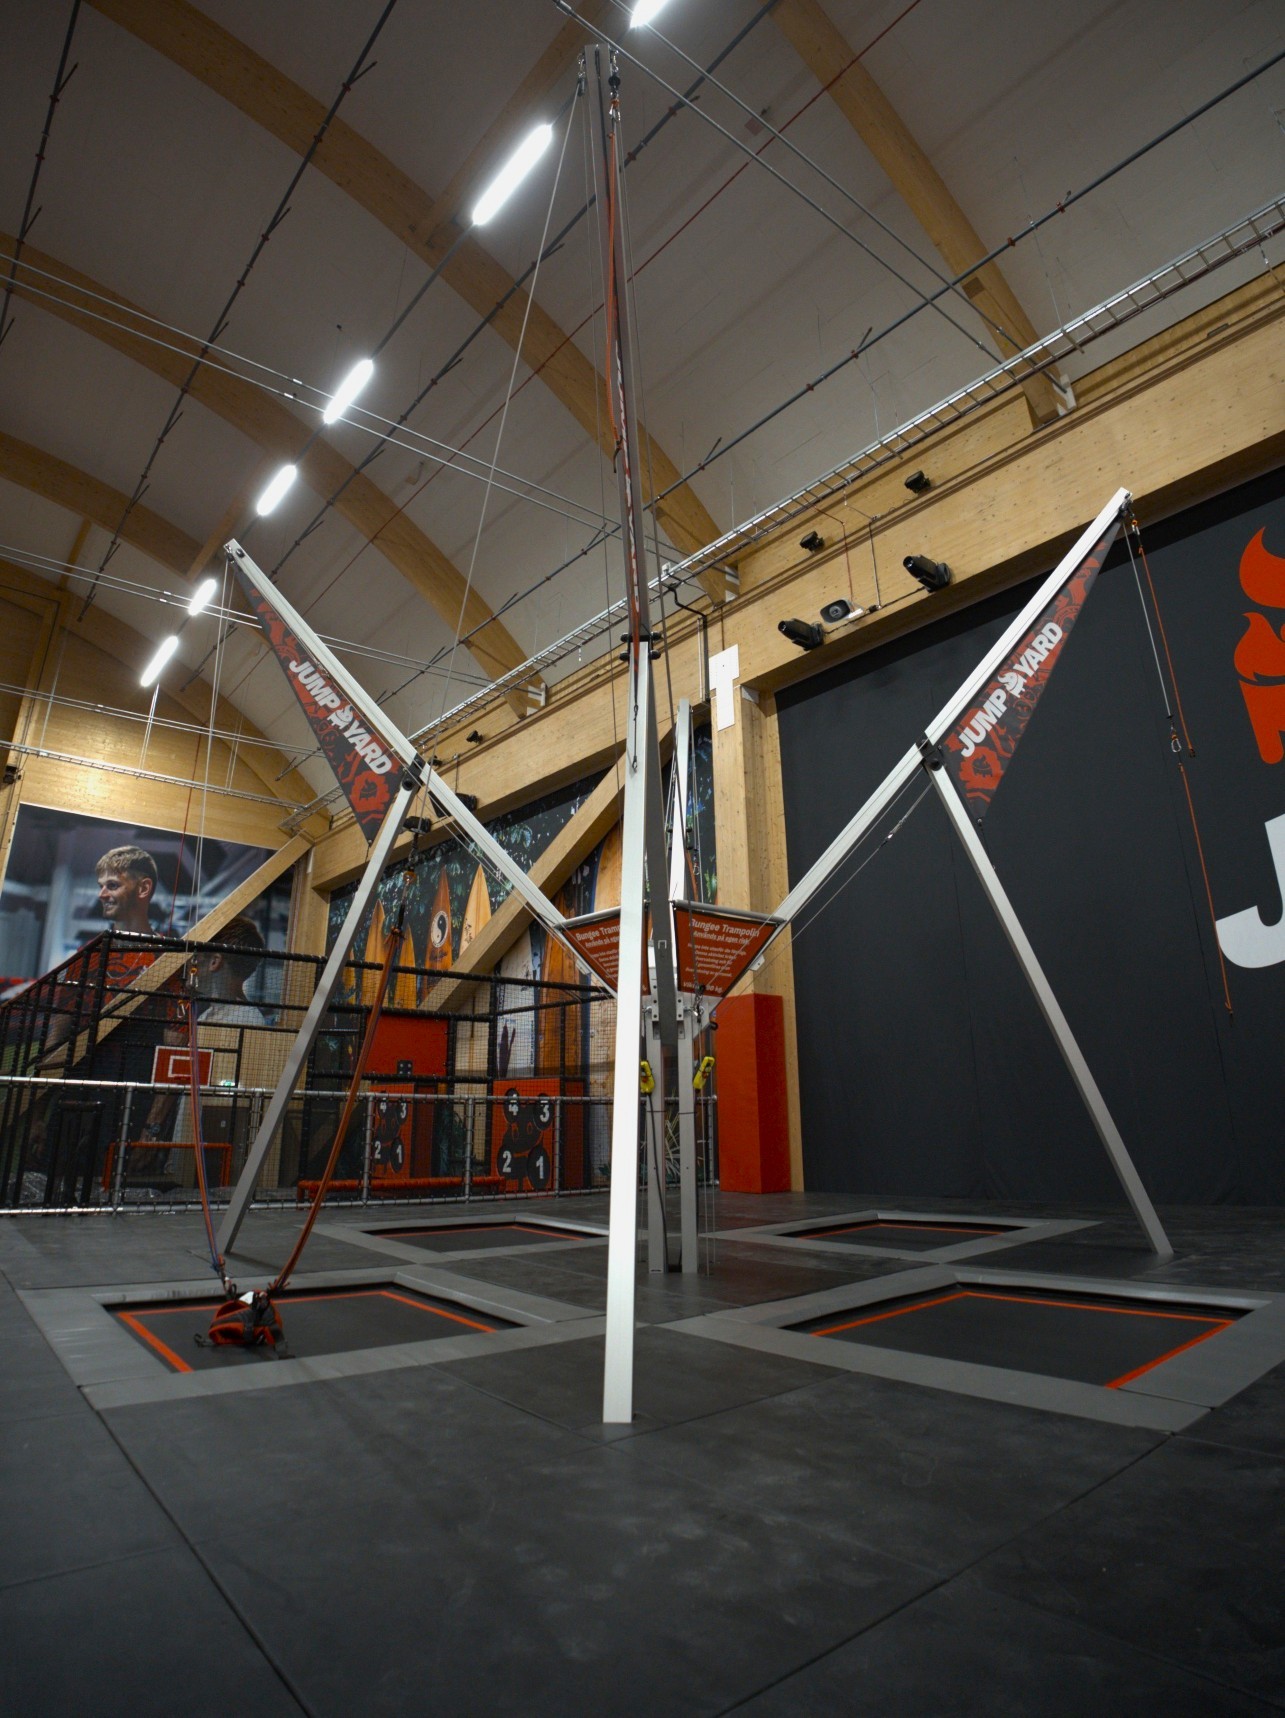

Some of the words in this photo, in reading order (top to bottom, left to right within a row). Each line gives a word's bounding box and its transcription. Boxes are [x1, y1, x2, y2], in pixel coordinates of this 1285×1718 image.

[958, 688, 1008, 758] JUMP
[1012, 621, 1063, 678] YARD
[289, 660, 341, 711] JUMP
[343, 719, 392, 775] YARD
[575, 930, 600, 941] Bungee
[688, 918, 720, 932] Bungee
[722, 923, 760, 937] Trampolin
[400, 1102, 407, 1119] 3
[508, 1093, 519, 1116] 4
[540, 1100, 550, 1122] 3
[374, 1140, 382, 1159] 2
[396, 1144, 402, 1164] 1
[502, 1150, 512, 1173] 2
[536, 1155, 544, 1179] 1
